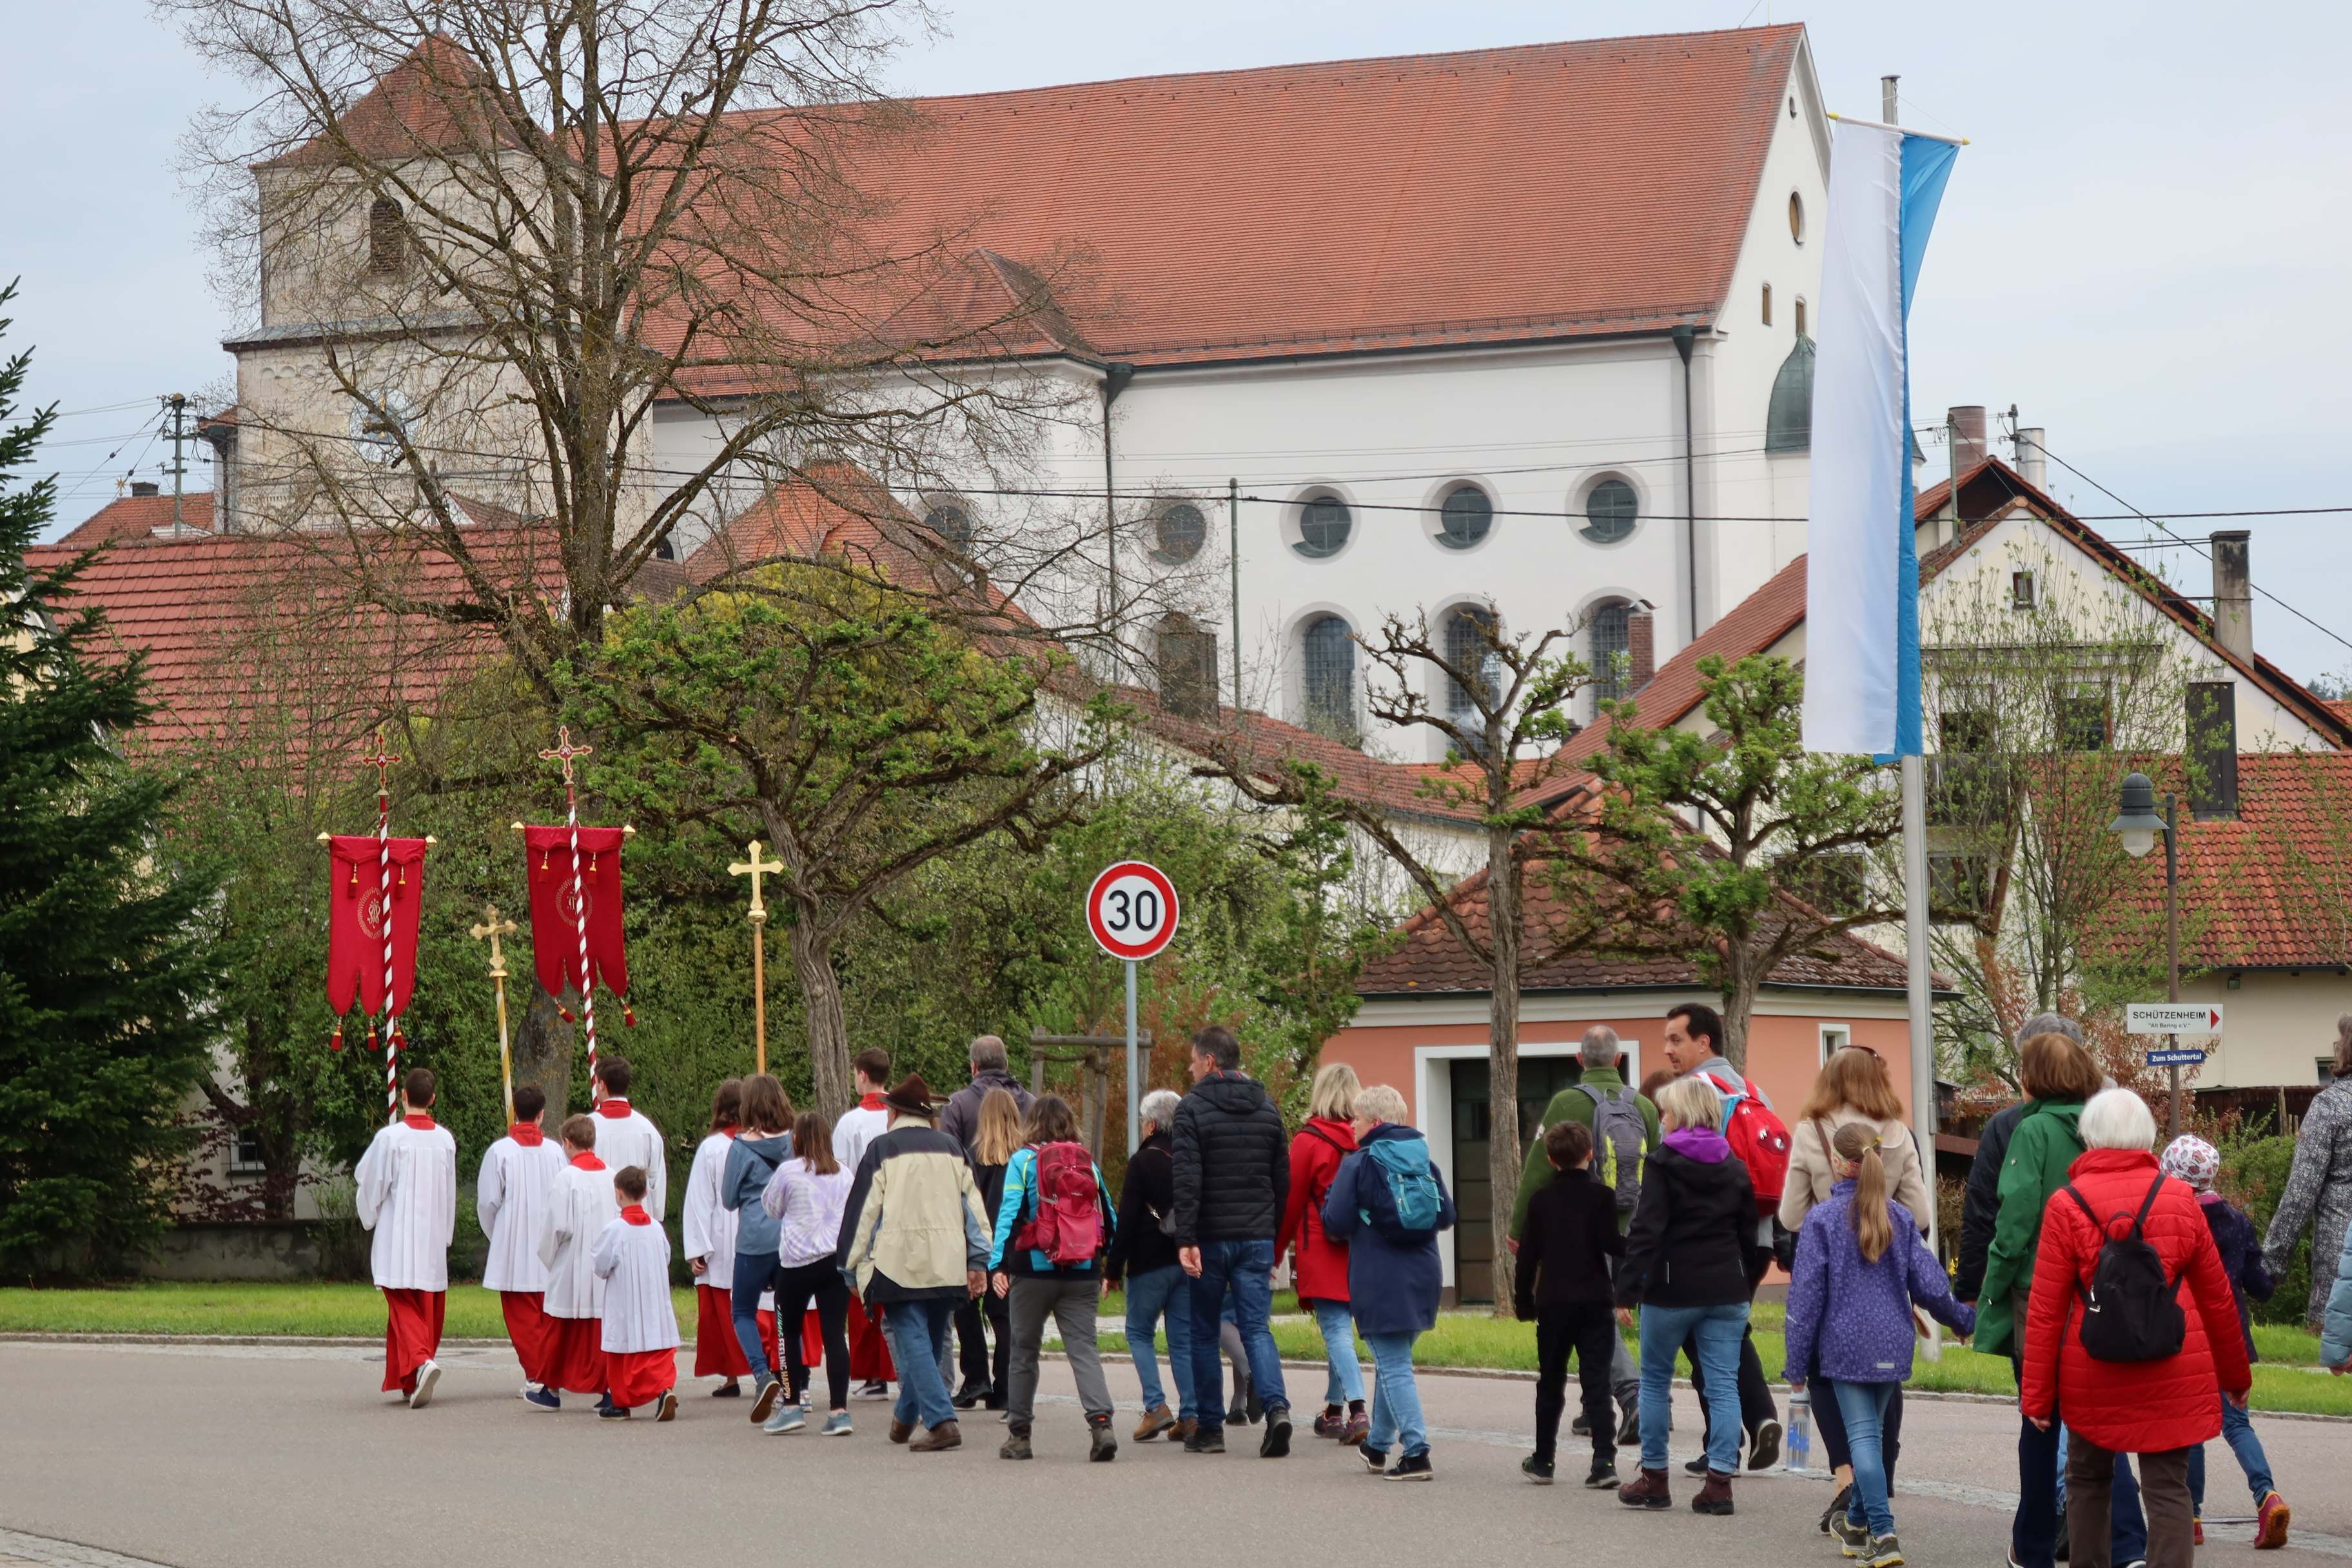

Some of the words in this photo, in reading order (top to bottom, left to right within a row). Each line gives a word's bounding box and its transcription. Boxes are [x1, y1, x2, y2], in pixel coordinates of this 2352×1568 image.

[1108, 890, 1157, 932] 30
[2133, 1010, 2206, 1019] SCHÜTZENHEIM
[2167, 1053, 2202, 1061] Schuttertal
[778, 1337, 787, 1370] FEELING
